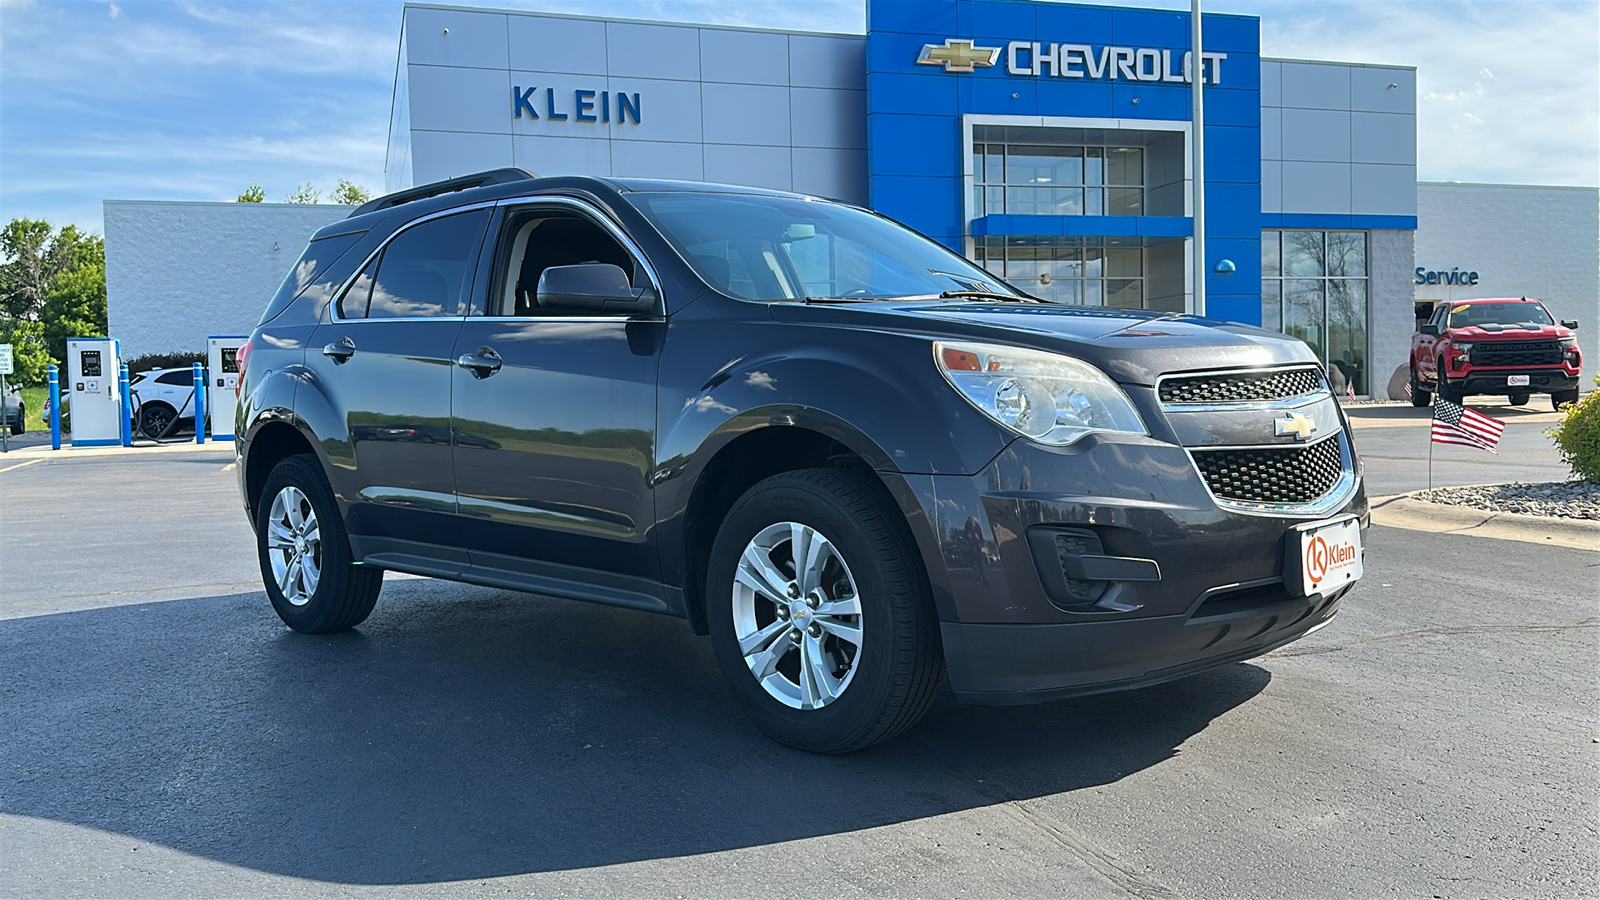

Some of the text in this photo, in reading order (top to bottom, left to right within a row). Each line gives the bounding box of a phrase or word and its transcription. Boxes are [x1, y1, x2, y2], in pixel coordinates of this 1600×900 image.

[1007, 41, 1228, 85] CHEVROLET
[513, 85, 641, 124] KLEIN
[1415, 267, 1479, 285] Service
[1329, 541, 1355, 565] Klein
